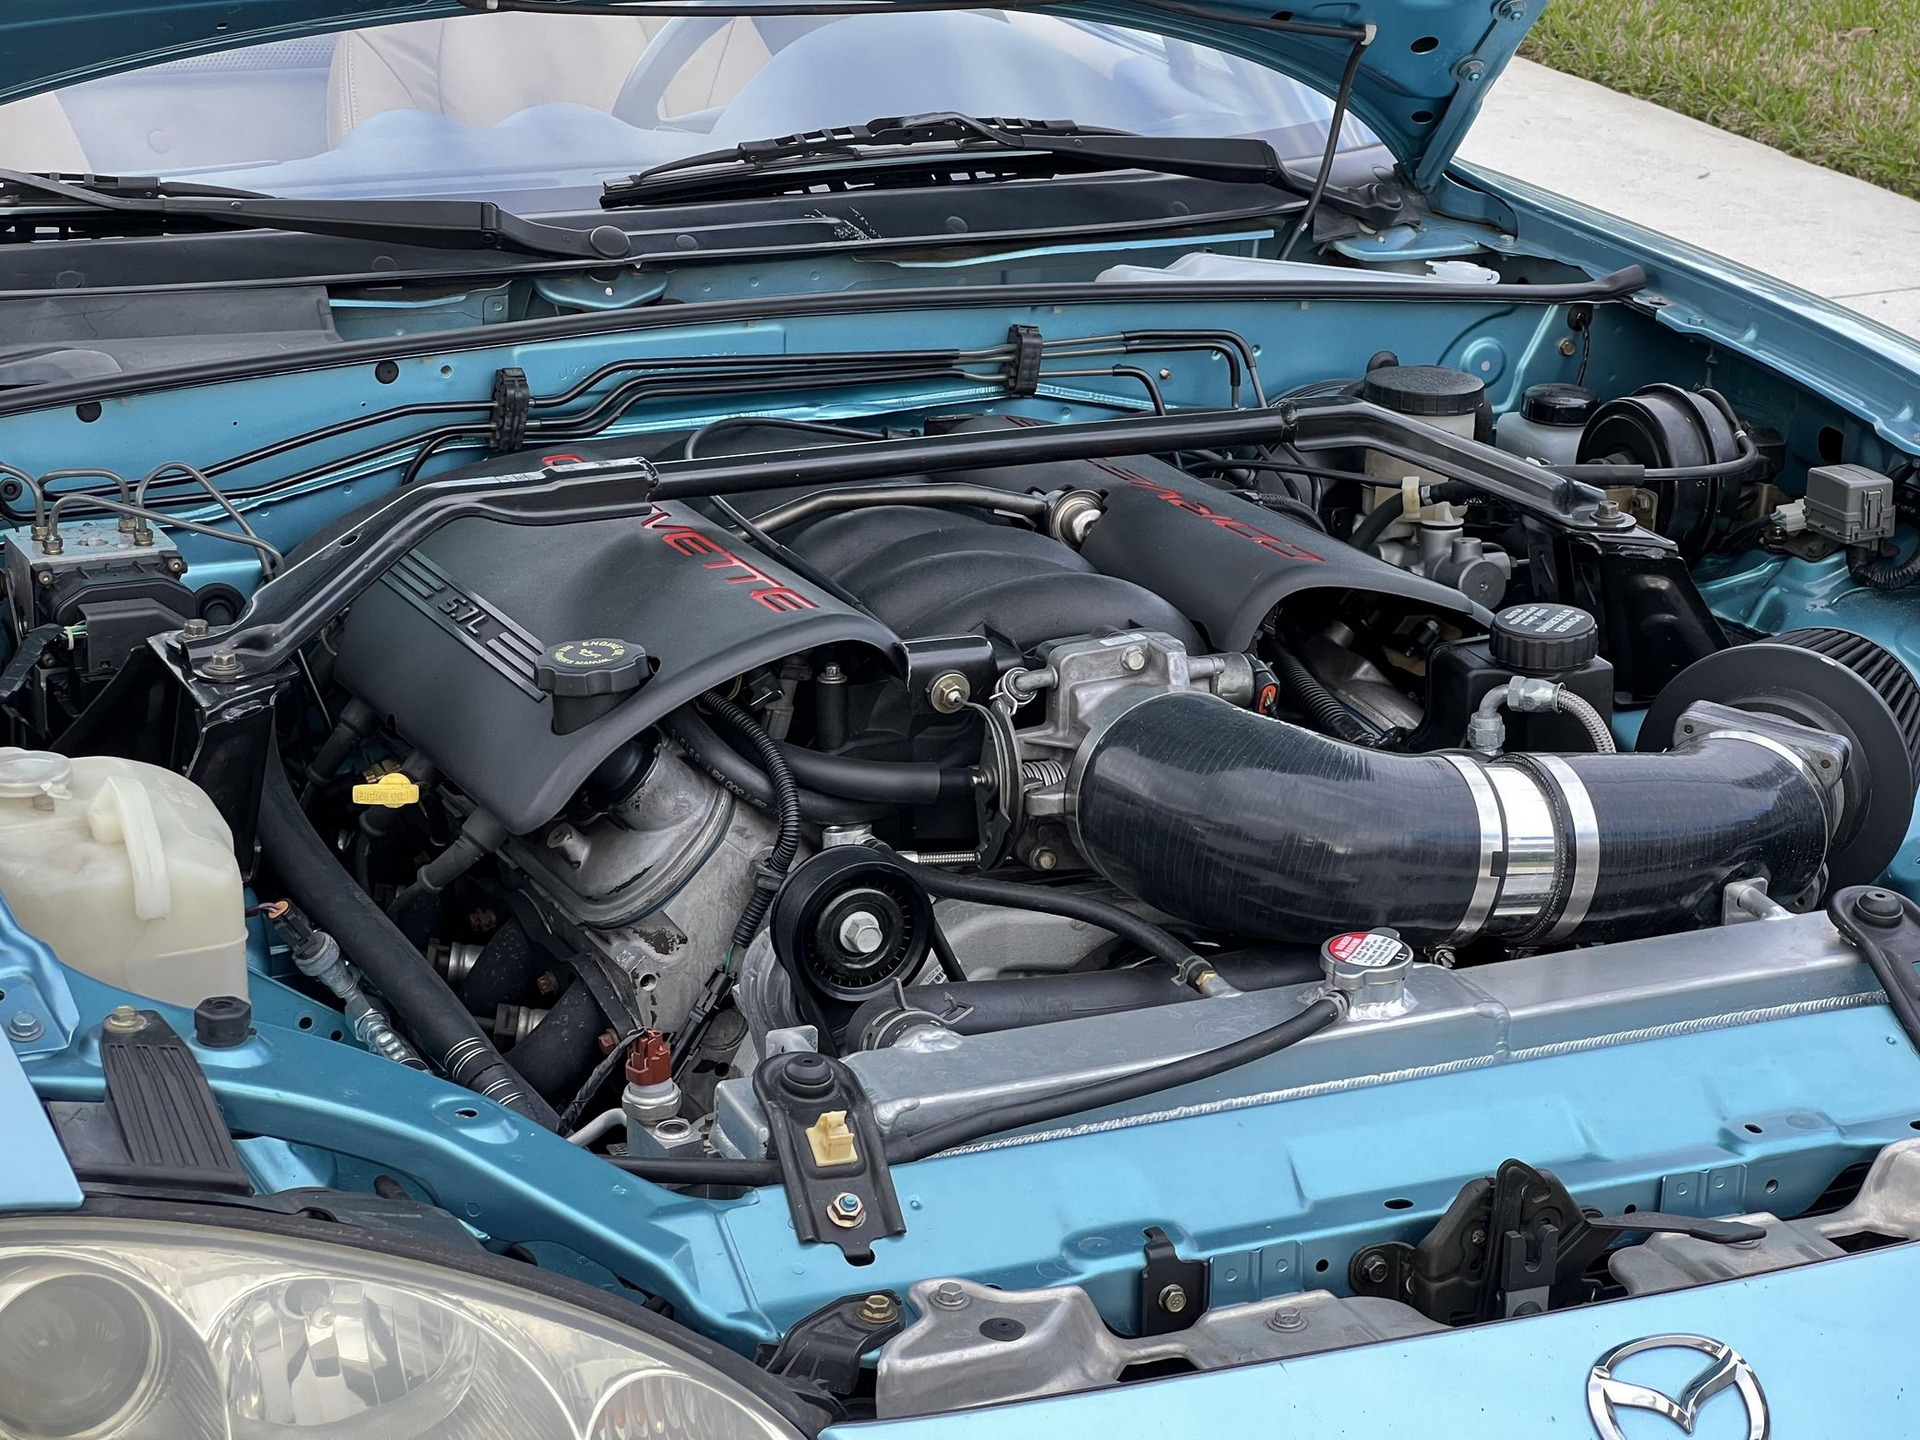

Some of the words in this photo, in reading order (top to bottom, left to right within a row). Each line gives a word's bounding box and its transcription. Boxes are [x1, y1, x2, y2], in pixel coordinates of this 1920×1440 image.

[542, 454, 820, 612] CVETTE
[438, 597, 487, 635] 5.7L
[1534, 609, 1575, 633] STEERING
[1553, 614, 1585, 632] POWER
[582, 641, 623, 650] ENGINE
